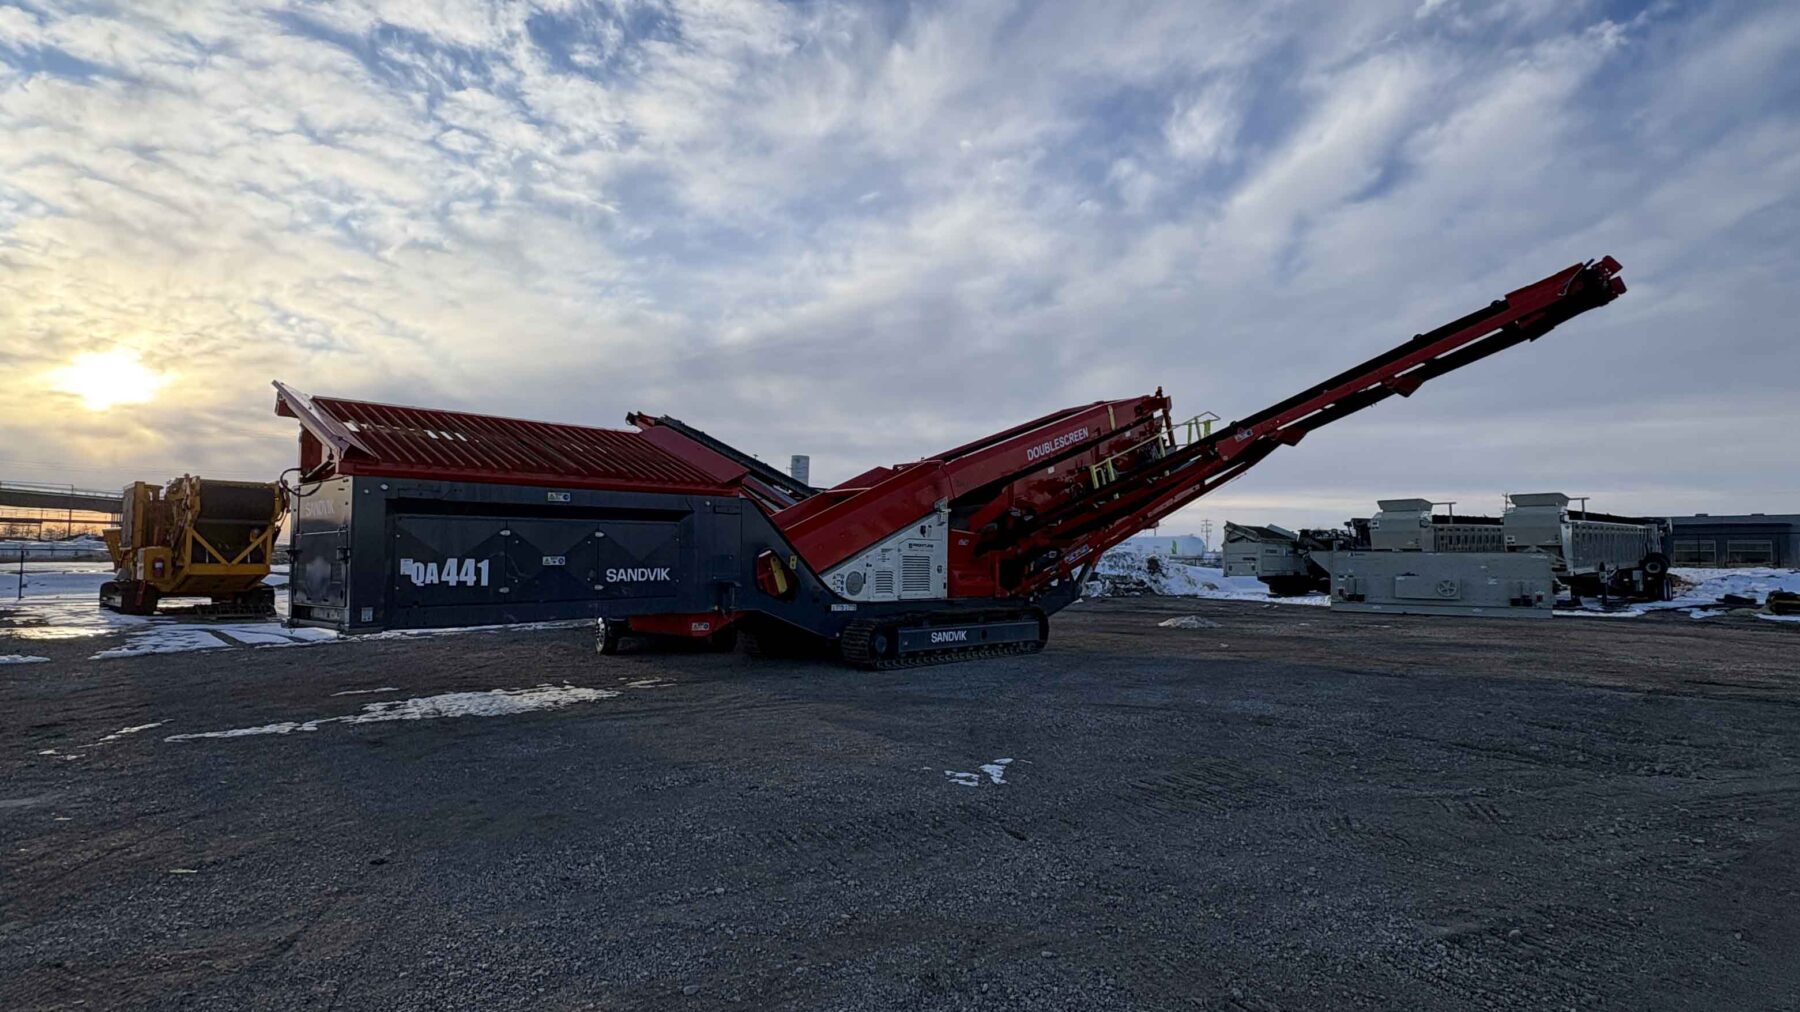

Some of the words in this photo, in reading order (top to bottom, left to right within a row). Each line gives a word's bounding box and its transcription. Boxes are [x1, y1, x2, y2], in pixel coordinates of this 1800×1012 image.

[1027, 427, 1089, 461] DOUBLESCREEN
[605, 567, 671, 582] SANDVIK
[930, 630, 967, 643] SANDVIK
